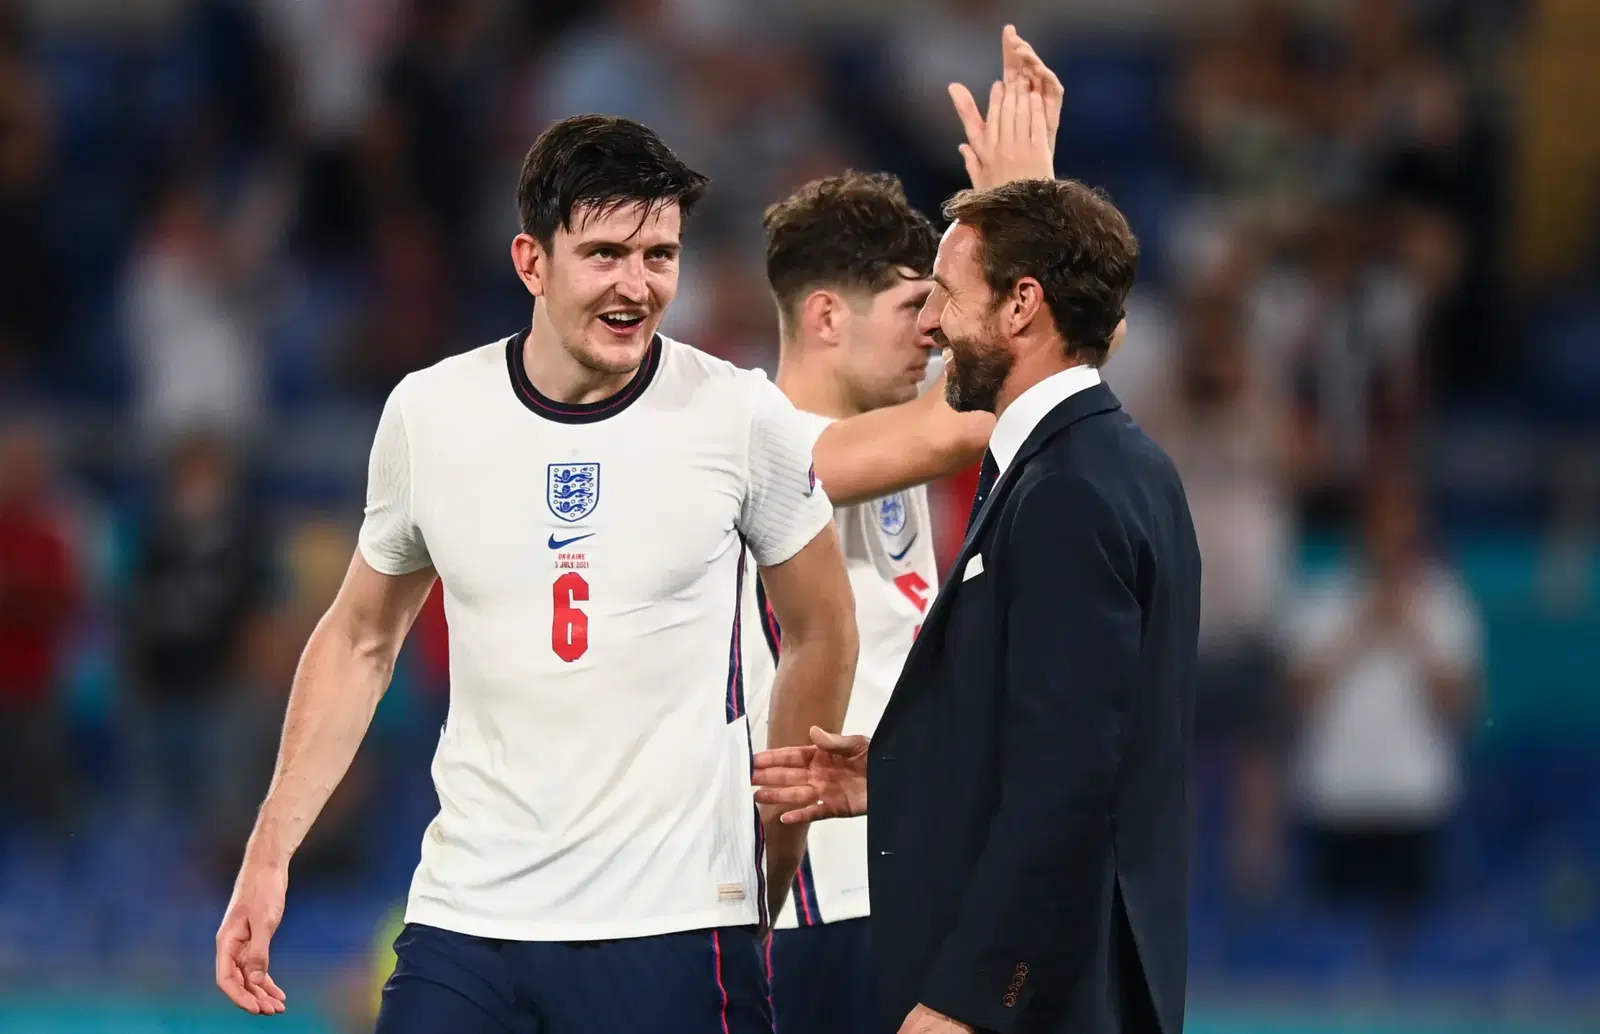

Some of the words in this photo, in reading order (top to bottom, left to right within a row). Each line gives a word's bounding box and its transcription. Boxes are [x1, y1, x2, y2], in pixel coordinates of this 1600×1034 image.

[560, 561, 574, 569] JULY
[576, 561, 590, 569] 2021
[552, 572, 589, 663] 6
